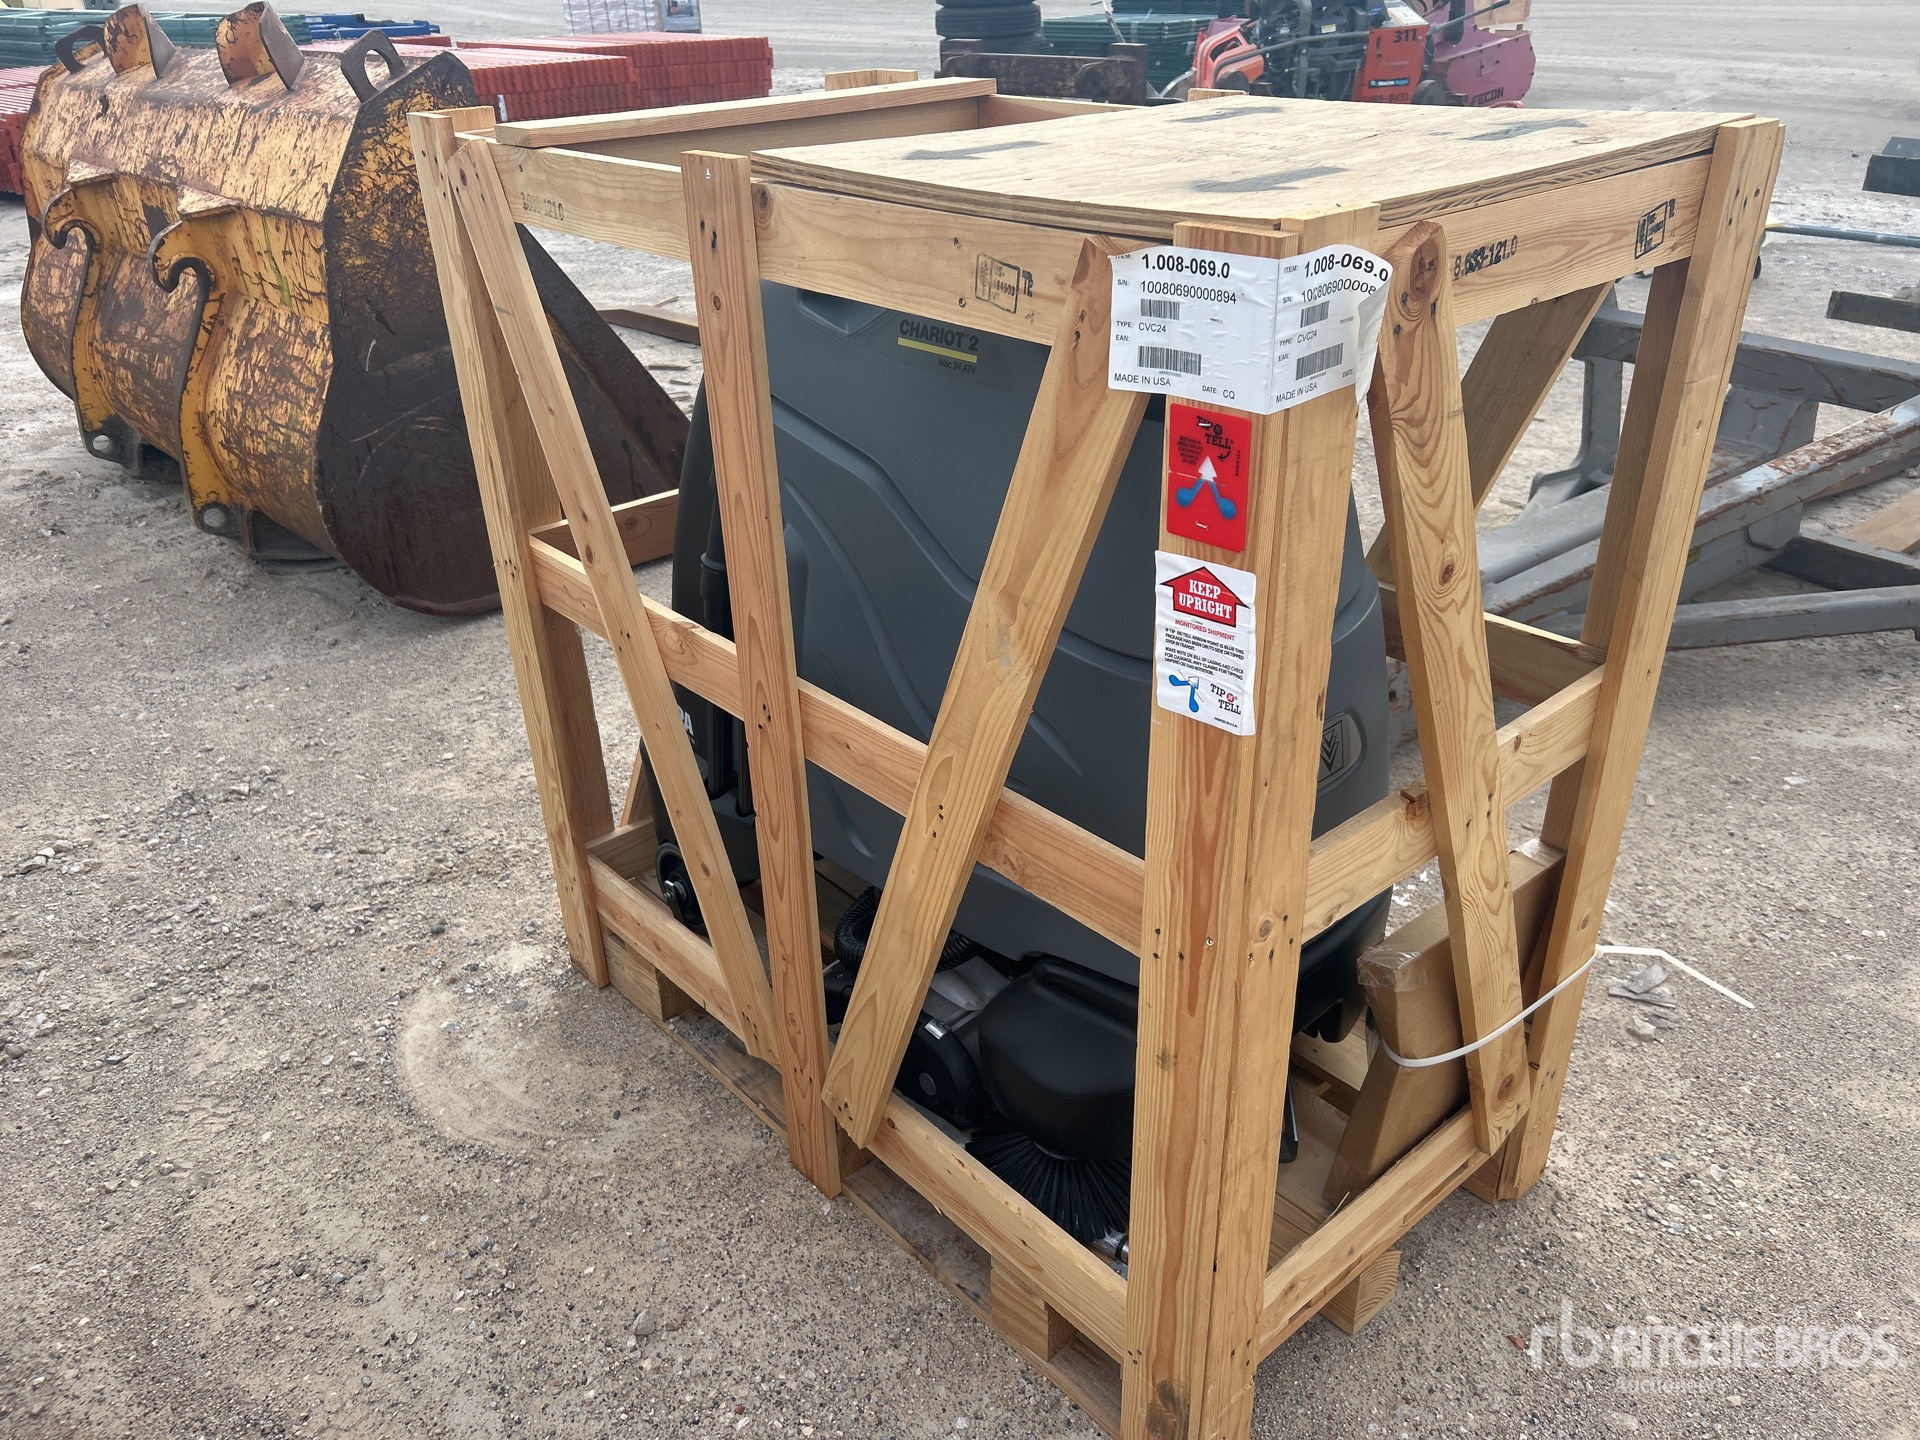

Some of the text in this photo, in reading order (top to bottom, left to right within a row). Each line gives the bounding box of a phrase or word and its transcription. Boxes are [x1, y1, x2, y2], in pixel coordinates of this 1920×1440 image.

[1393, 29, 1417, 43] 311
[1141, 253, 1231, 279] 1.008-069.0
[1283, 253, 1389, 282] ITEM: 1.008-069.0
[1140, 280, 1237, 304] 10080690000894
[899, 319, 979, 352] CHARIOT 2
[1116, 320, 1167, 333] TYPE: CVC24
[1296, 329, 1318, 344] CVC24
[1114, 373, 1172, 387] MADE IN USA
[1202, 385, 1236, 400] DATE: CQ
[1275, 381, 1318, 404] MADE IN USA
[1189, 579, 1221, 600] KEEP
[1178, 592, 1232, 619] UPRIGHT
[1174, 619, 1236, 641] MONITORED SHIPMENT
[1210, 683, 1226, 697] TIP
[1218, 699, 1242, 715] TELL
